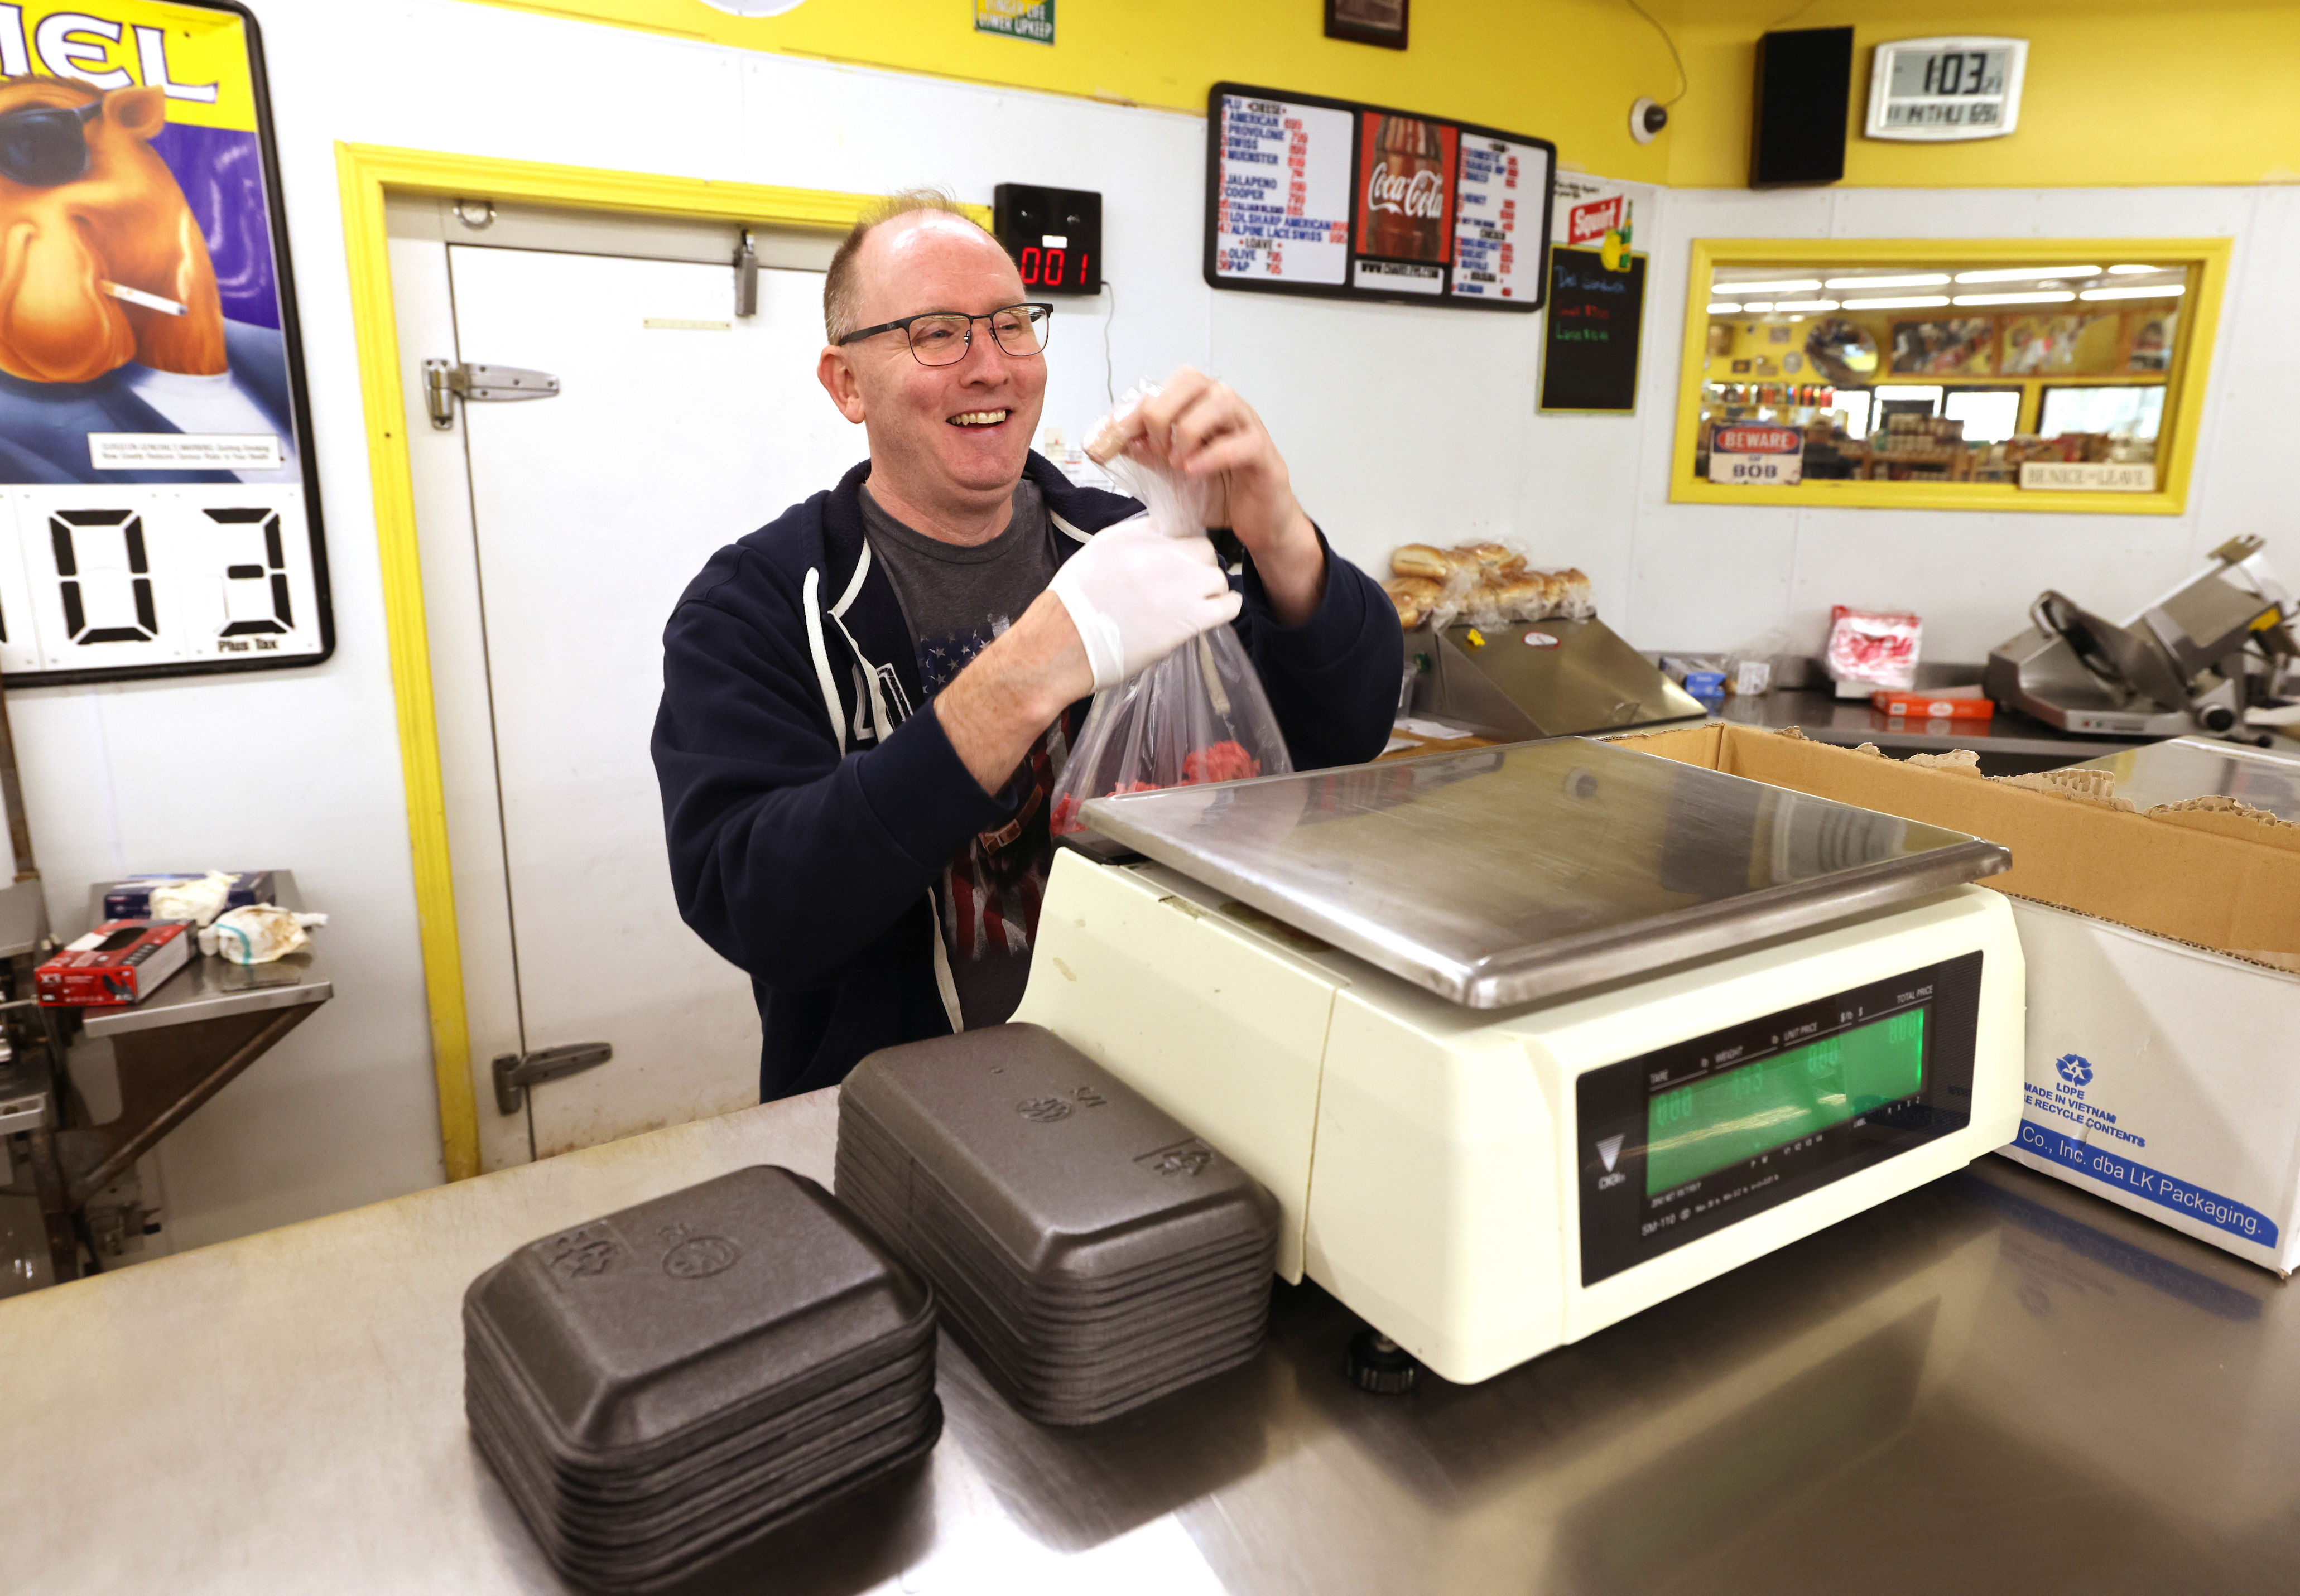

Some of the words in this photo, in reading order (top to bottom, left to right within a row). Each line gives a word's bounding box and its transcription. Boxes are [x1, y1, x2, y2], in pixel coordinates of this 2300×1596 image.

[1014, 17, 1053, 39] UPKEEP
[1229, 112, 1279, 128] AMERICAN
[1228, 124, 1285, 141] PROVOLONE
[1228, 137, 1258, 150] SWISS
[1228, 150, 1278, 165] MUENSTER
[1225, 186, 1264, 201] COOPER
[1368, 162, 1443, 218] Coca-Cola
[1284, 217, 1332, 230] AMERICAN
[1574, 201, 1617, 238] Squirt
[1231, 225, 1264, 237] ALPINE
[1292, 230, 1322, 242] SWISS
[1229, 248, 1255, 261] OLIVE
[1725, 431, 1791, 449] BEWARE
[1733, 464, 1777, 478] BOB
[218, 639, 249, 653] Plus
[256, 638, 278, 650] Tax
[1897, 991, 1916, 1005] TOTAL
[1916, 985, 1933, 1000] PRICE
[1800, 1022, 1818, 1036] PRICE
[1715, 1046, 1744, 1064] WEIGHT
[2056, 1082, 2085, 1100] LDPE
[2024, 1082, 2053, 1100] MADE
[2055, 1094, 2066, 1105] IN
[2068, 1098, 2116, 1124] VIETNAM
[2035, 1098, 2084, 1124] RECYCLE
[2085, 1118, 2146, 1148] CONTENTS
[2023, 1126, 2053, 1154] Co.,
[2059, 1139, 2086, 1165] Inc.
[2093, 1155, 2124, 1179] dba
[2130, 1167, 2154, 1192] LK
[2159, 1178, 2262, 1235] Packaging.
